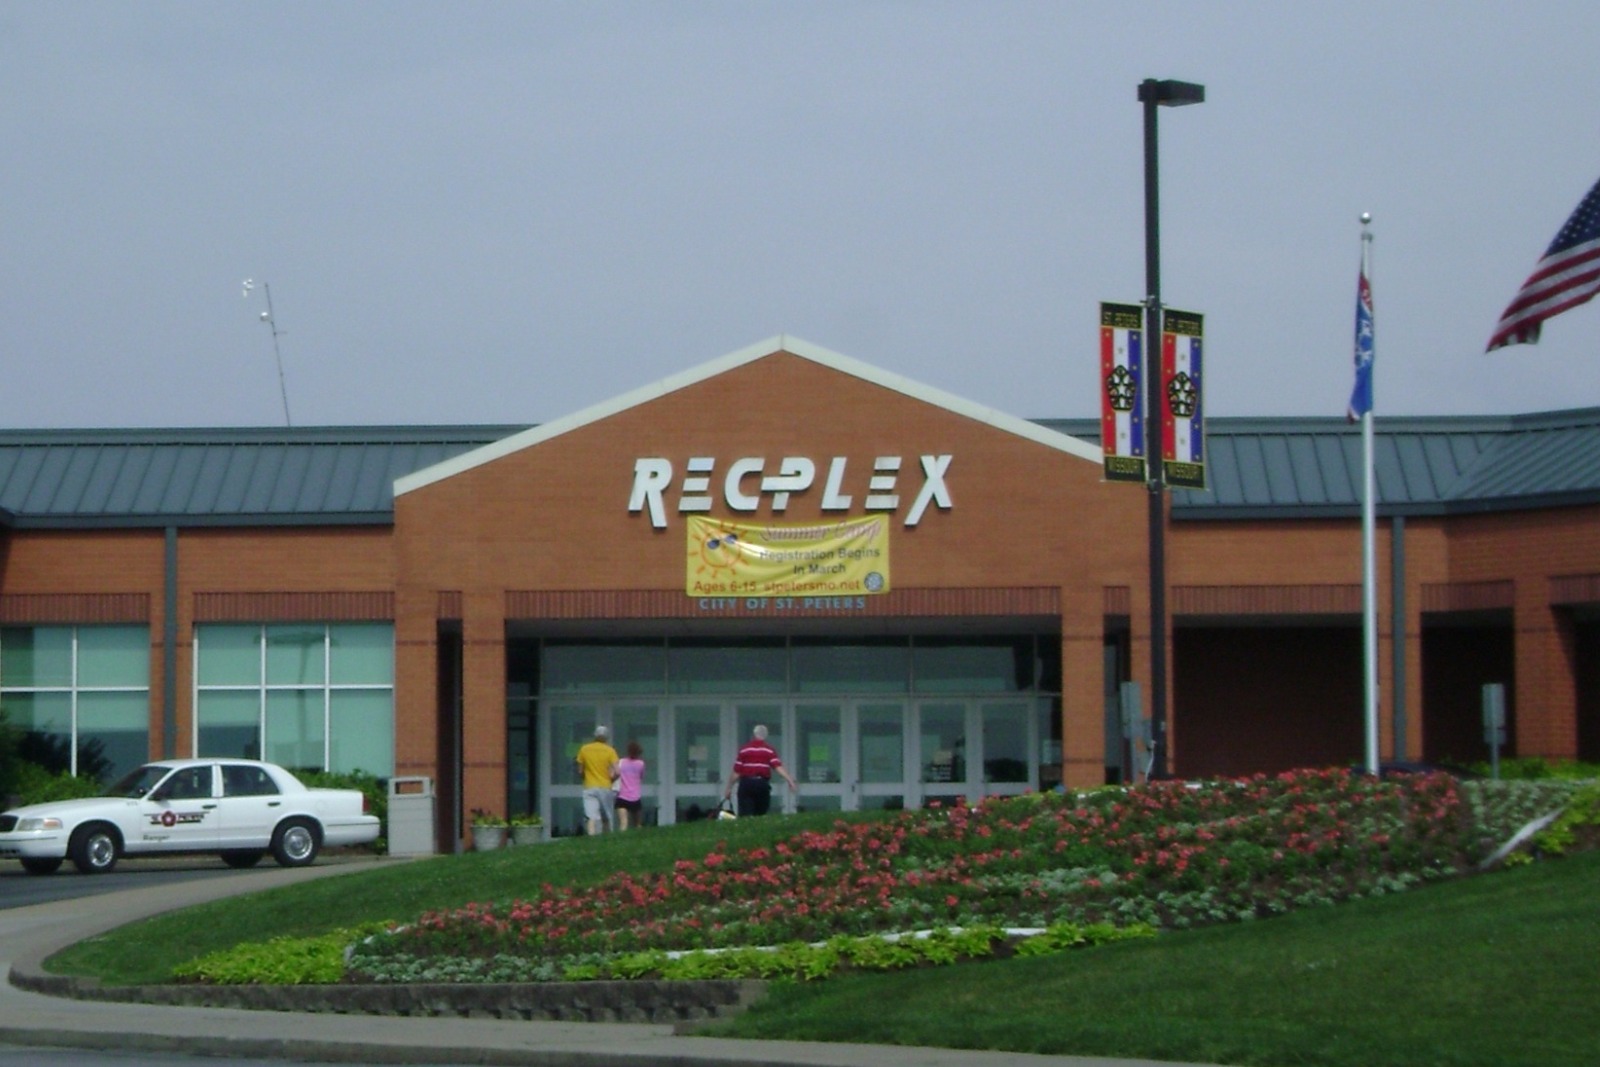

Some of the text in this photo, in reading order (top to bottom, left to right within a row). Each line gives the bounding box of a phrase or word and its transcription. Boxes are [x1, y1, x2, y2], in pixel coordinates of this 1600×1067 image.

[628, 455, 953, 528] RECPLEX
[760, 547, 881, 563] Registration Begins
[809, 563, 846, 574] March
[694, 581, 724, 594] Ages
[699, 598, 736, 609] CITY
[746, 598, 769, 609] OF
[804, 597, 866, 609] PETERS
